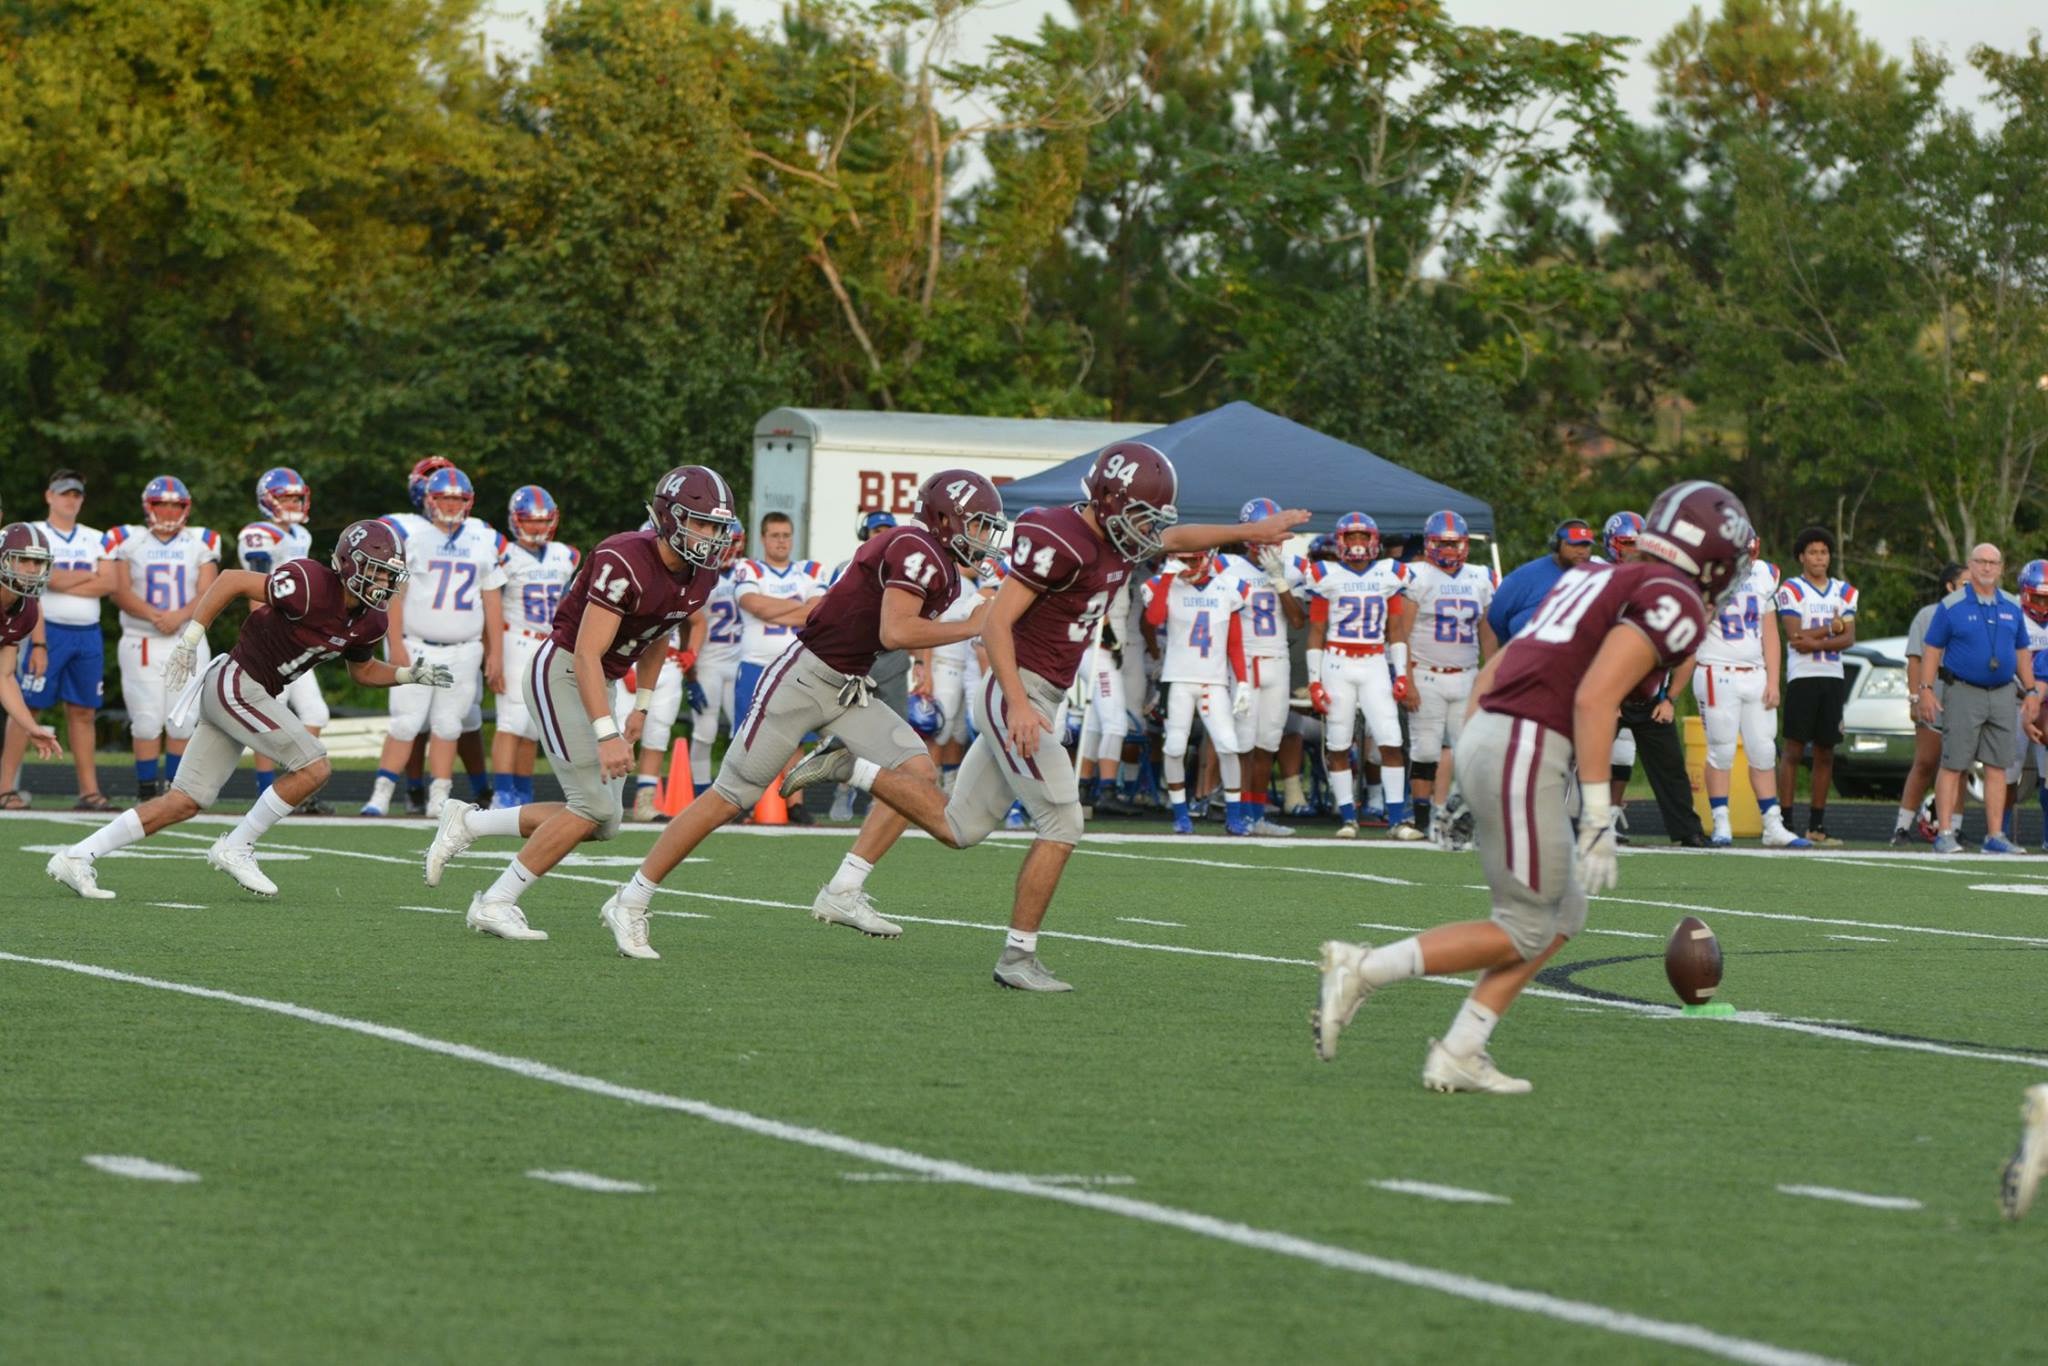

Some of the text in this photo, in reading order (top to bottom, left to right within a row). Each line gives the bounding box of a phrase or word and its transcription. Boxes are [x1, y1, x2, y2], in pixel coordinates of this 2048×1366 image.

[662, 474, 687, 497] 14
[1103, 454, 1139, 486] 94
[945, 479, 978, 507] 41
[346, 525, 369, 546] 13
[1719, 507, 1749, 548] 30
[903, 551, 938, 589] 41
[1013, 536, 1056, 578] 94
[145, 563, 187, 611] 61
[428, 560, 477, 610] 72
[593, 563, 630, 604] 14
[1183, 596, 1220, 609] CLEVELAND
[1343, 582, 1380, 592] CLEVELAND
[1067, 590, 1109, 642] 9
[1189, 611, 1213, 658] 4
[1338, 595, 1385, 639] 20
[1434, 598, 1480, 644] 63
[1645, 594, 1698, 653] 30
[1719, 595, 1760, 641] 64
